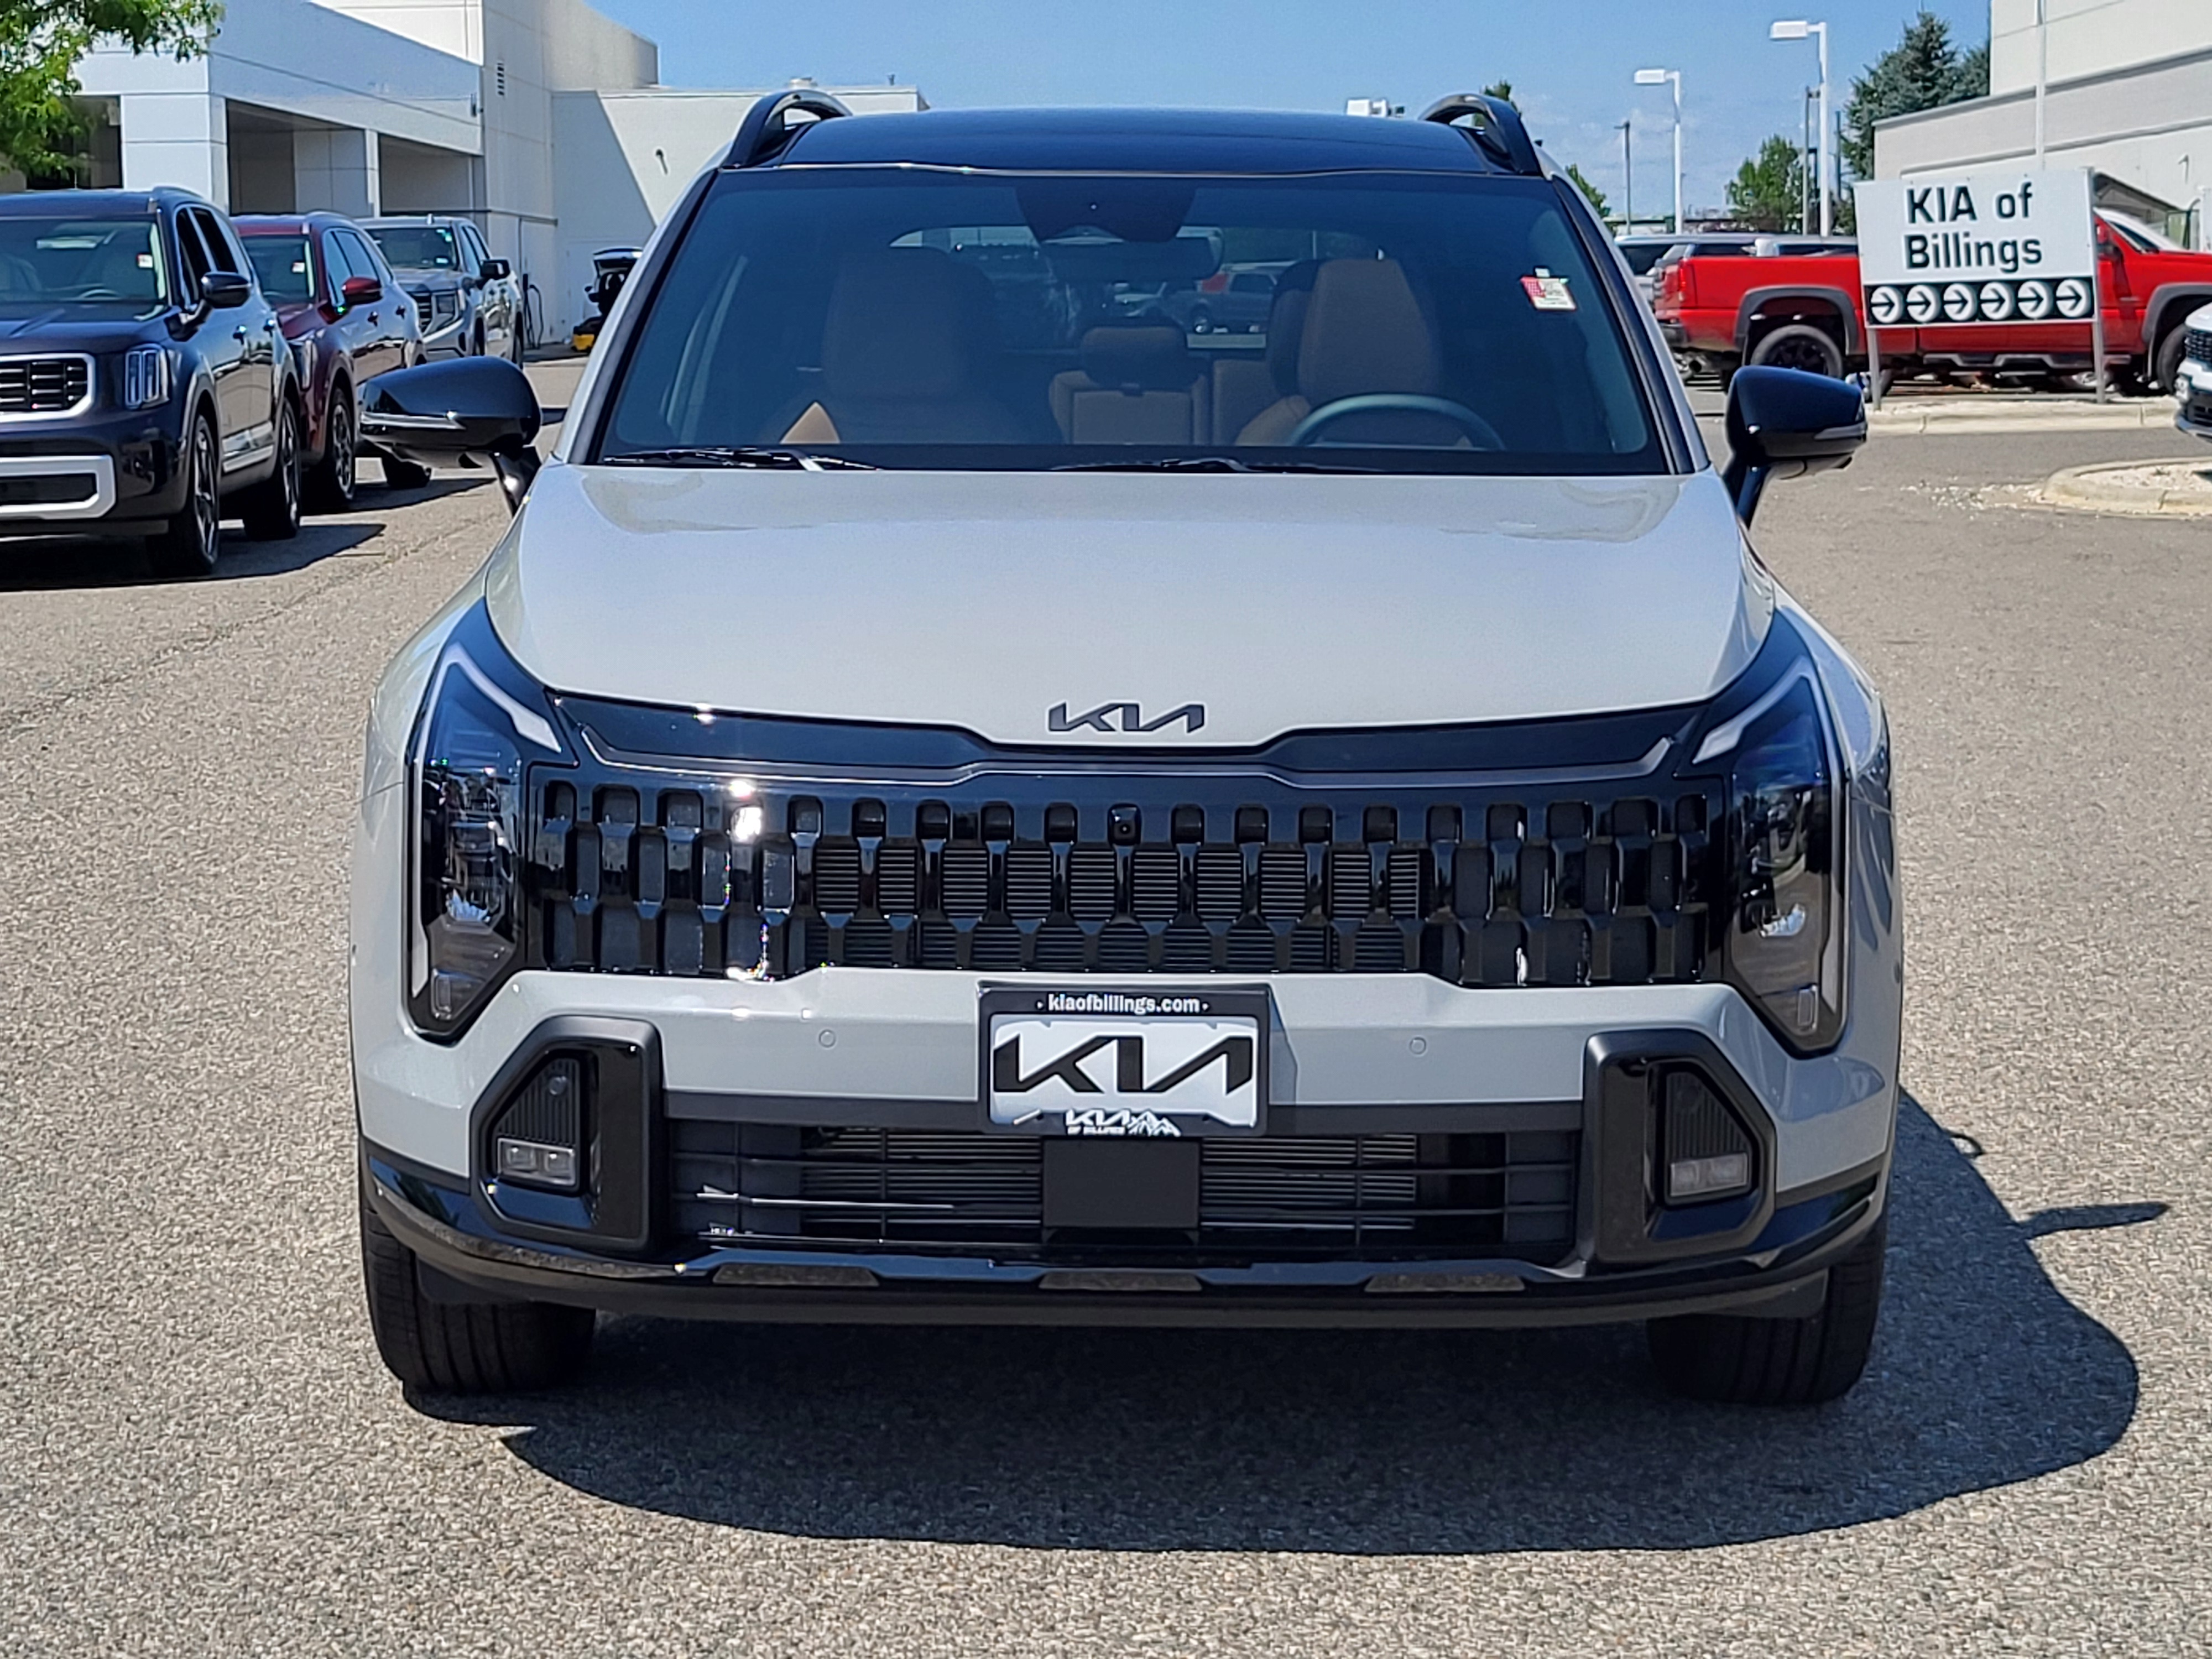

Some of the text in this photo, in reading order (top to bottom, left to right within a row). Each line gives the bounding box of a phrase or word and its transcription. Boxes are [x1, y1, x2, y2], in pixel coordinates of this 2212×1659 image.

[1907, 181, 2033, 223] KIA of
[1905, 231, 2043, 274] Billings
[1048, 701, 1204, 734] KIA
[1048, 993, 1200, 1015] kiaofbillings.com
[993, 1034, 1253, 1095] KIA
[1066, 1109, 1130, 1126] KIA
